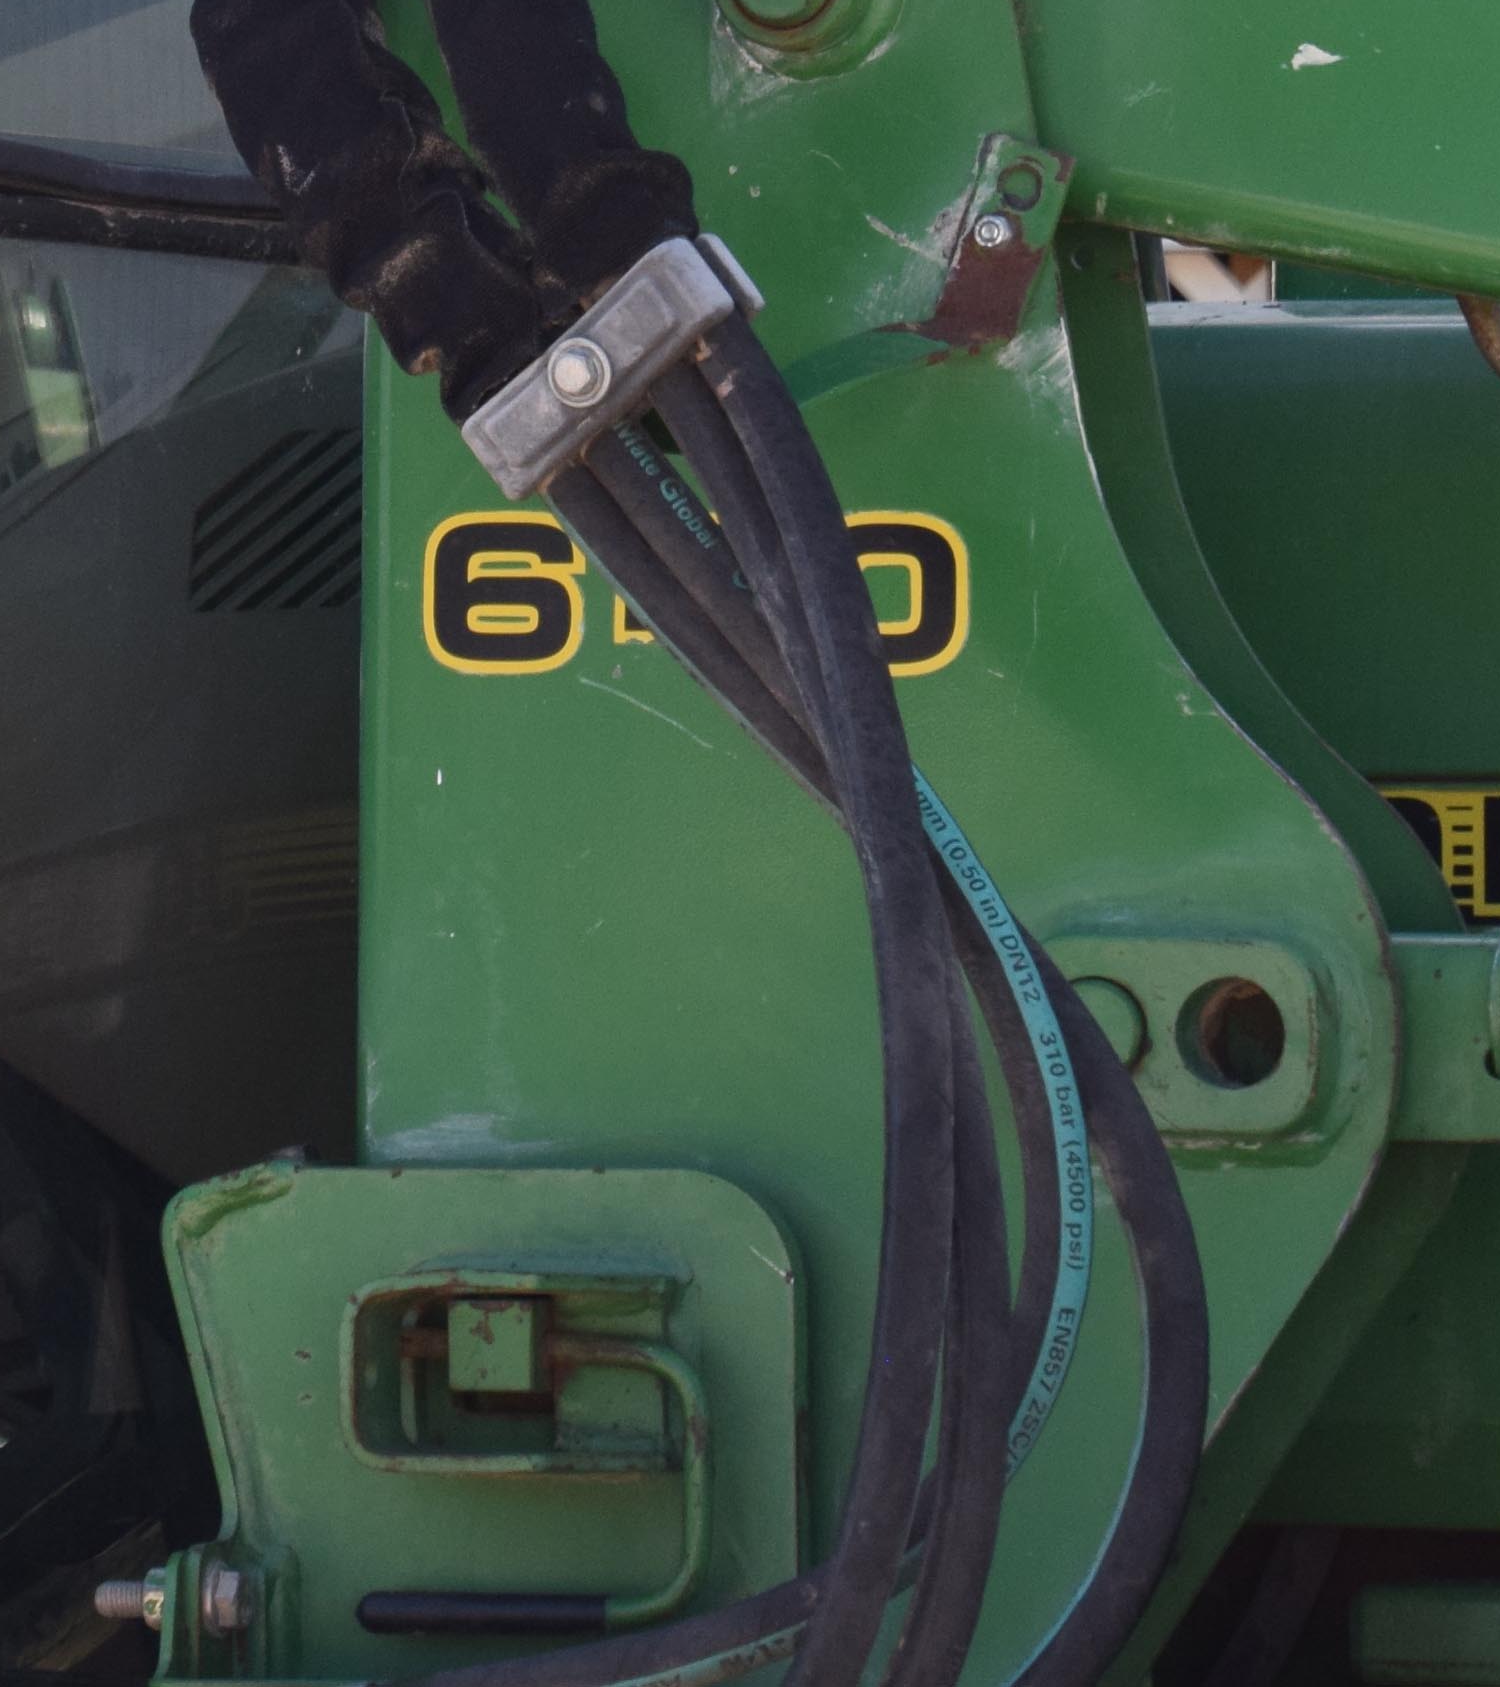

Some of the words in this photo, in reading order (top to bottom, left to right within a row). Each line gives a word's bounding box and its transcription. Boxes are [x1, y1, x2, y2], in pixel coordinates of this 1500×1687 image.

[423, 510, 970, 676] 60
[942, 838, 987, 892] (0.50
[979, 897, 1008, 928] in)
[999, 935, 1041, 1003] DN12
[1039, 1031, 1067, 1077] 310
[1056, 1086, 1076, 1128] bar
[1062, 1140, 1086, 1212] (4500
[1065, 1223, 1085, 1270] psi)
[1039, 1307, 1077, 1393] EN857
